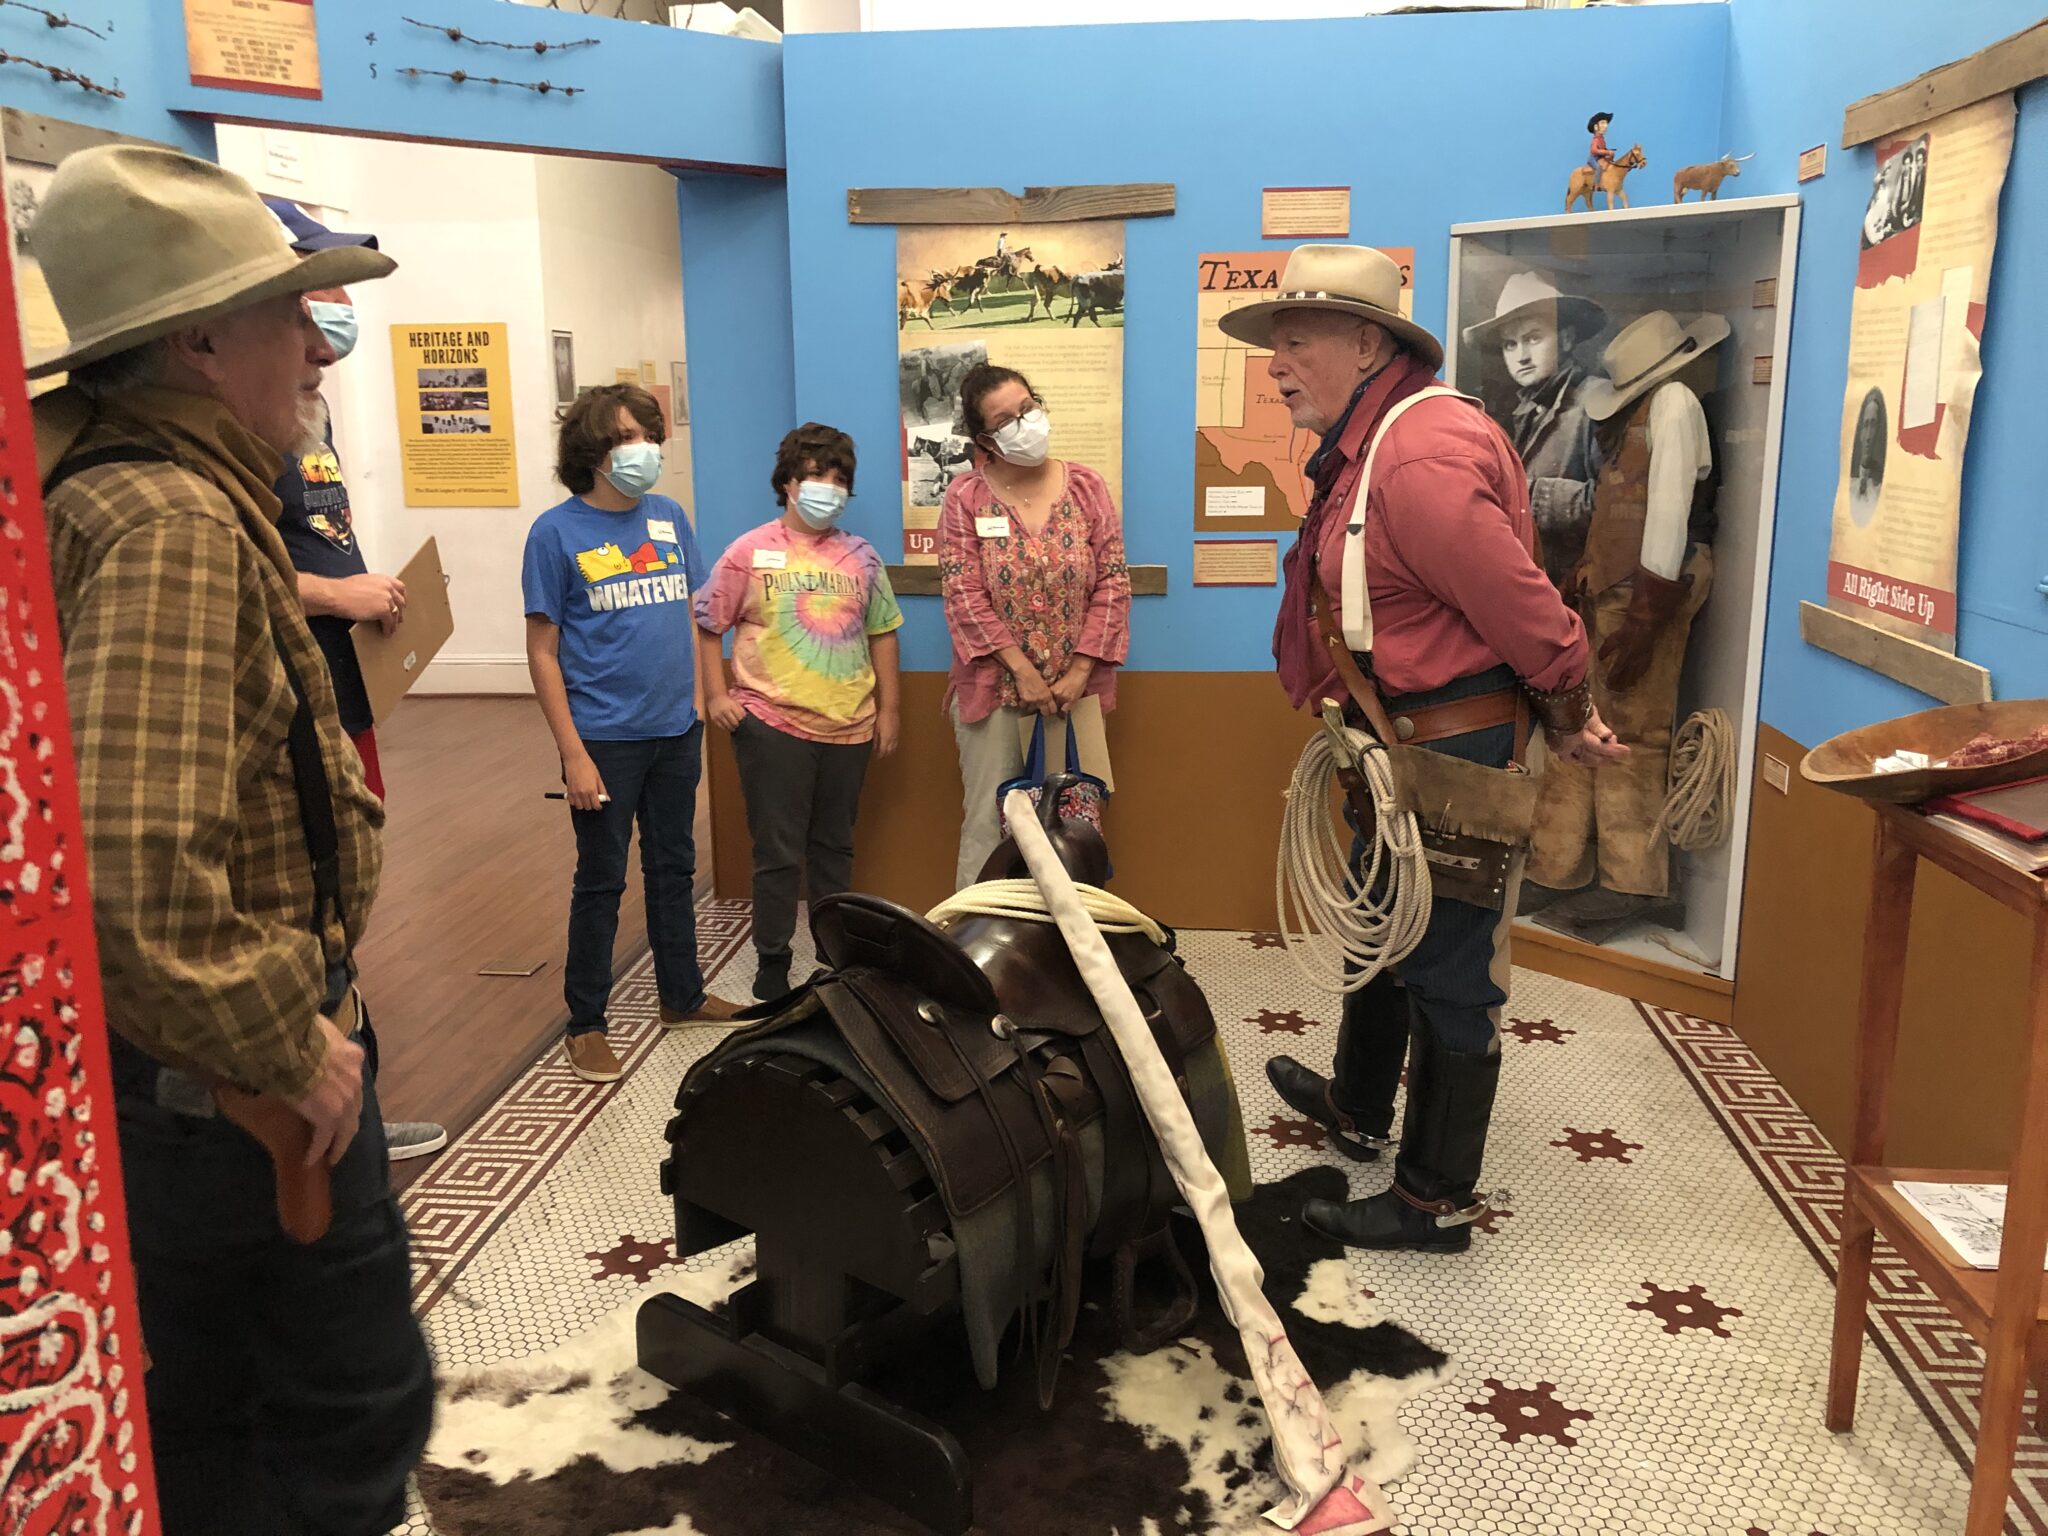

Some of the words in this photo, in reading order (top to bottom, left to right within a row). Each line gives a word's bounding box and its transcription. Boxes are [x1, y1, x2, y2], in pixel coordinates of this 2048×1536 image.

[1200, 260, 1279, 290] TEXA
[409, 331, 463, 348] HERITAGE
[467, 331, 490, 347] AND
[423, 348, 479, 364] HORIZONS
[909, 533, 934, 553] Up
[1842, 572, 1858, 596] All
[1858, 576, 1890, 608] Right
[1889, 585, 1915, 614] Side
[1917, 592, 1935, 625] Up
